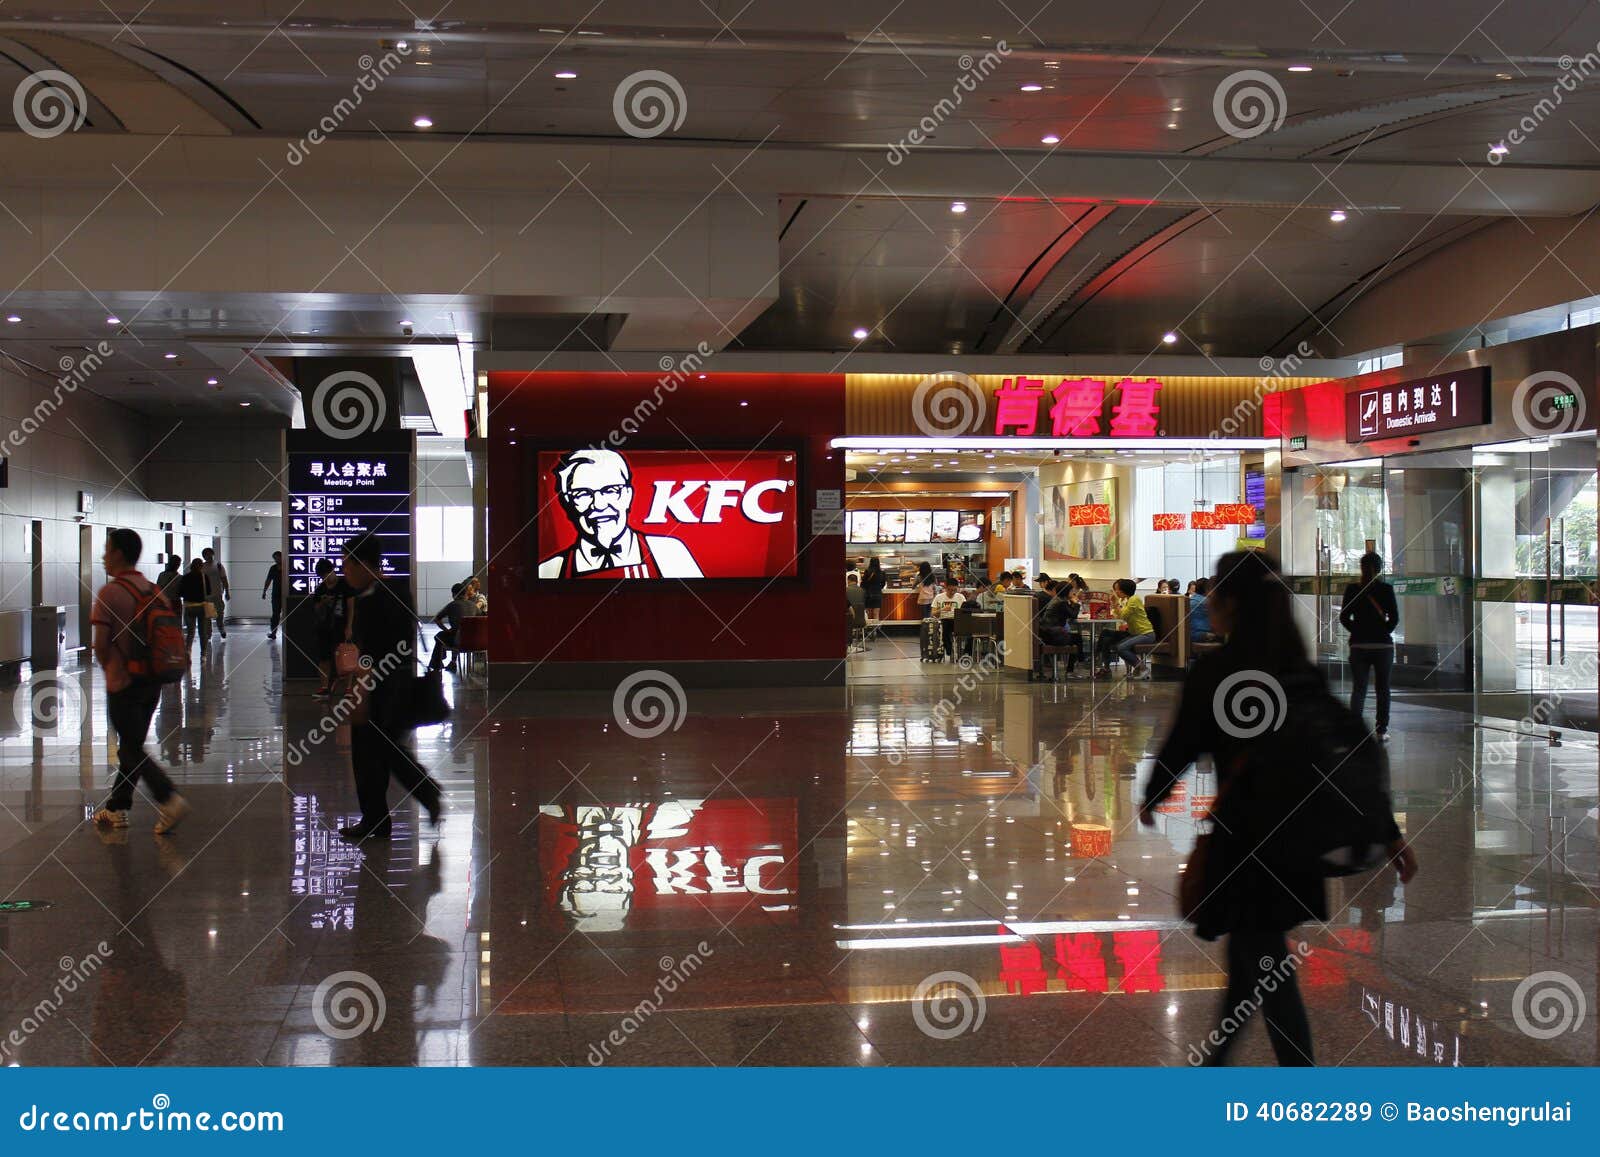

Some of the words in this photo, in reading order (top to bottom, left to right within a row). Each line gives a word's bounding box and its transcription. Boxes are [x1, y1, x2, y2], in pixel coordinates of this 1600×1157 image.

[994, 376, 1163, 437] 肯德基
[1382, 383, 1442, 415] 国内到达
[1450, 381, 1457, 417] 1
[1386, 414, 1413, 429] Domestic
[1413, 410, 1437, 425] Arrivals
[310, 462, 387, 477] 寻人会聚点
[324, 479, 353, 487] Meeting
